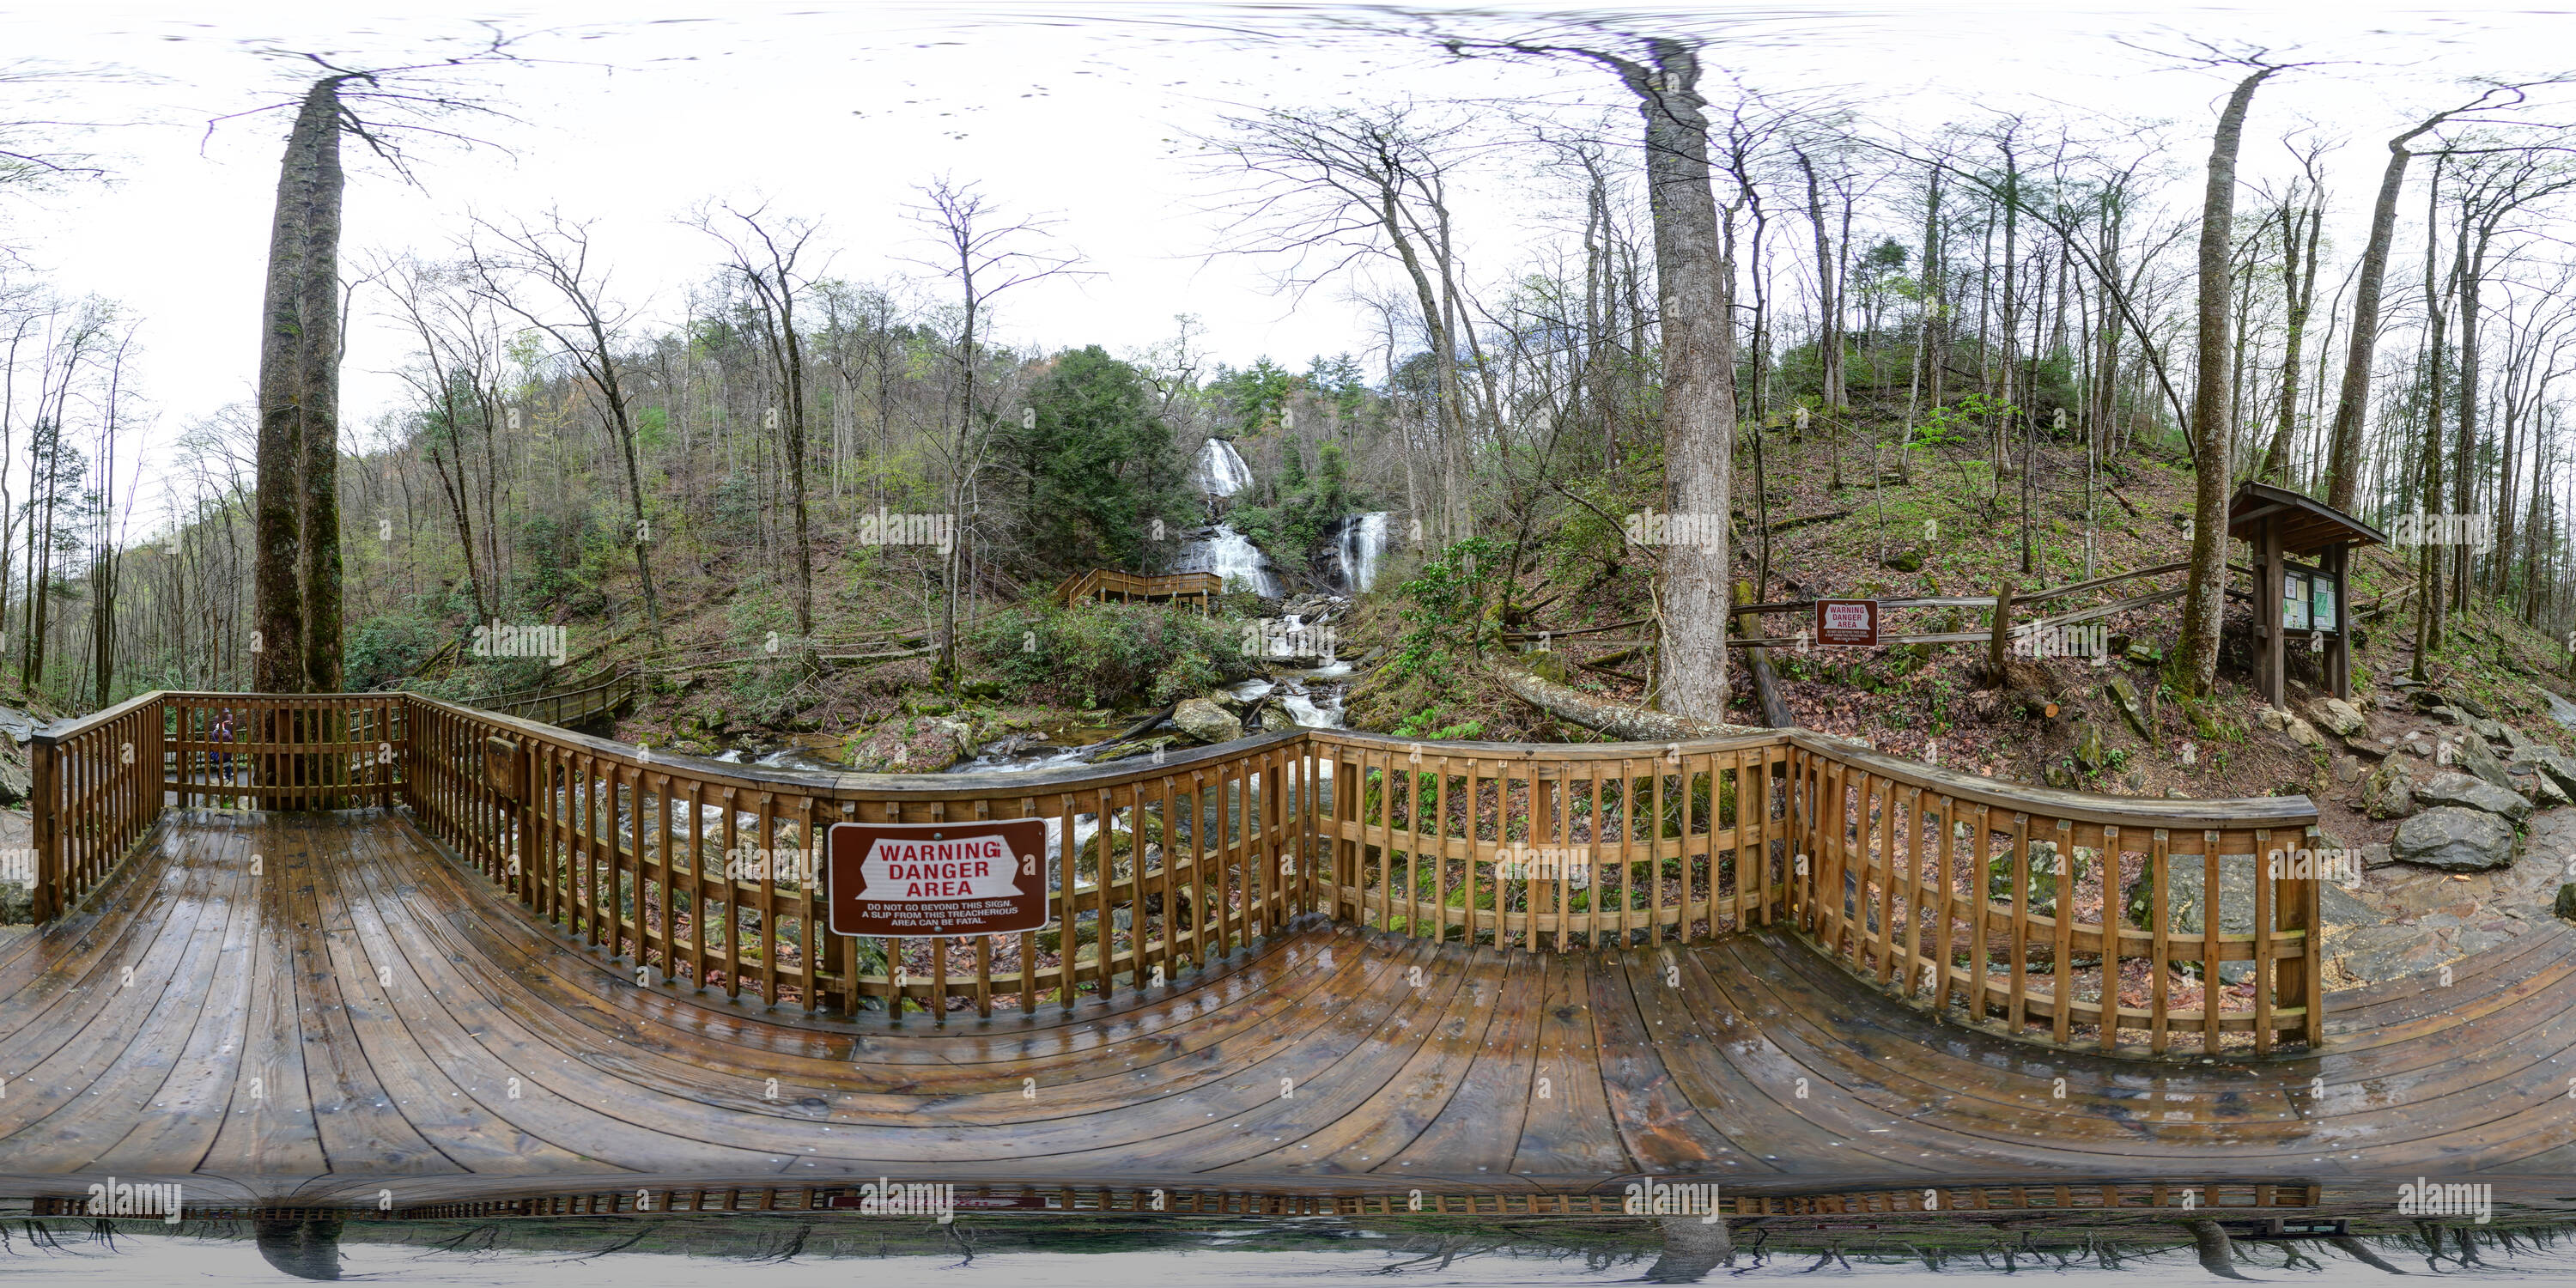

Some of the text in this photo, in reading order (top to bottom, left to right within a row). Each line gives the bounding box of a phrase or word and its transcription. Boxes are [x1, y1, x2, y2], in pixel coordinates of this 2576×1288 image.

[879, 841, 1000, 861] WARNING
[889, 861, 989, 880] DANGER
[907, 880, 973, 897] AREA
[921, 902, 959, 911] BEYOND
[962, 902, 982, 910] THIS
[924, 910, 945, 919] THIS
[957, 917, 987, 926] FATAL.
